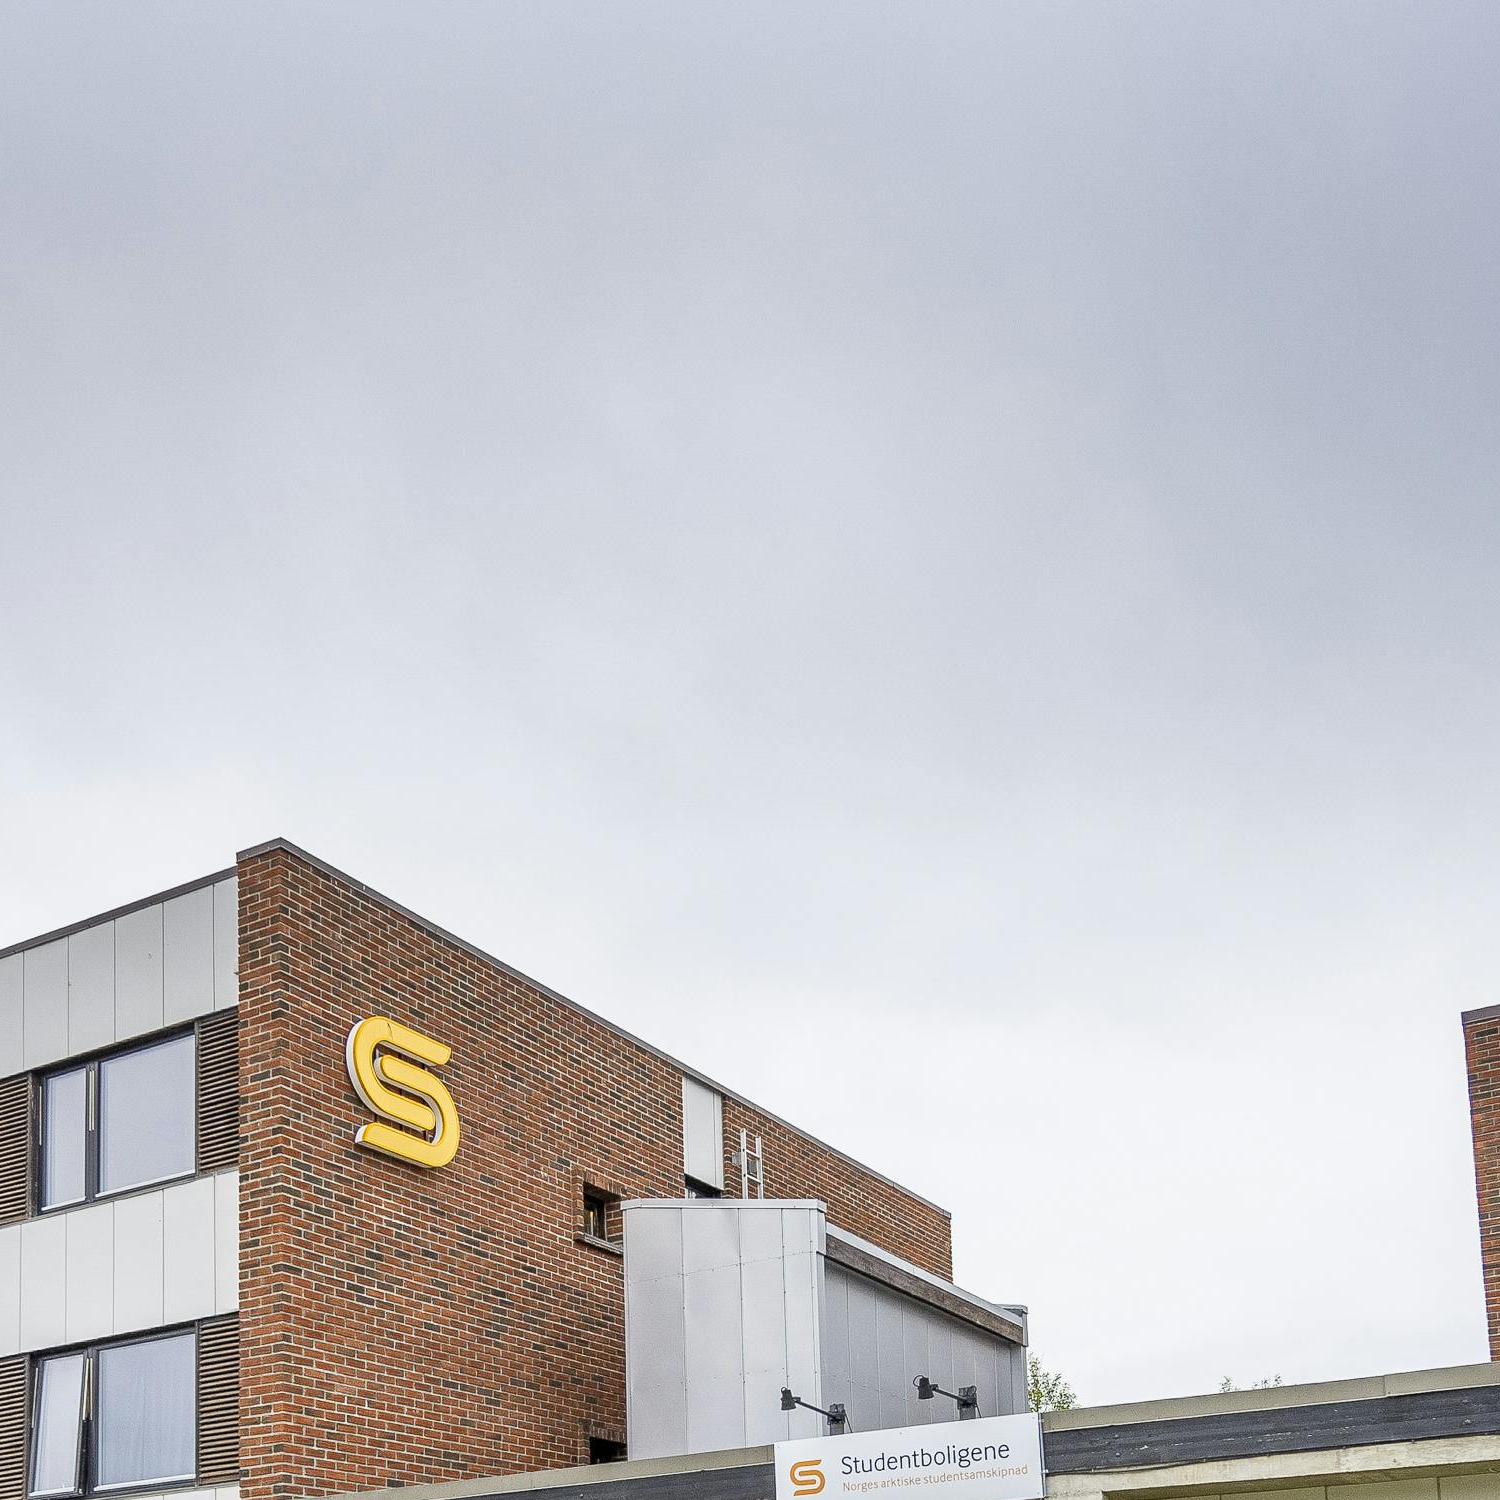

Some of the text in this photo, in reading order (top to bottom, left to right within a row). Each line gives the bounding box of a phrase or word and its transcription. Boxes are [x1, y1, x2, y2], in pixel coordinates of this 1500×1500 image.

[841, 1443, 1011, 1476] Studentboligene
[843, 1464, 1029, 1493] Norges arktiske studentsamskipnad
